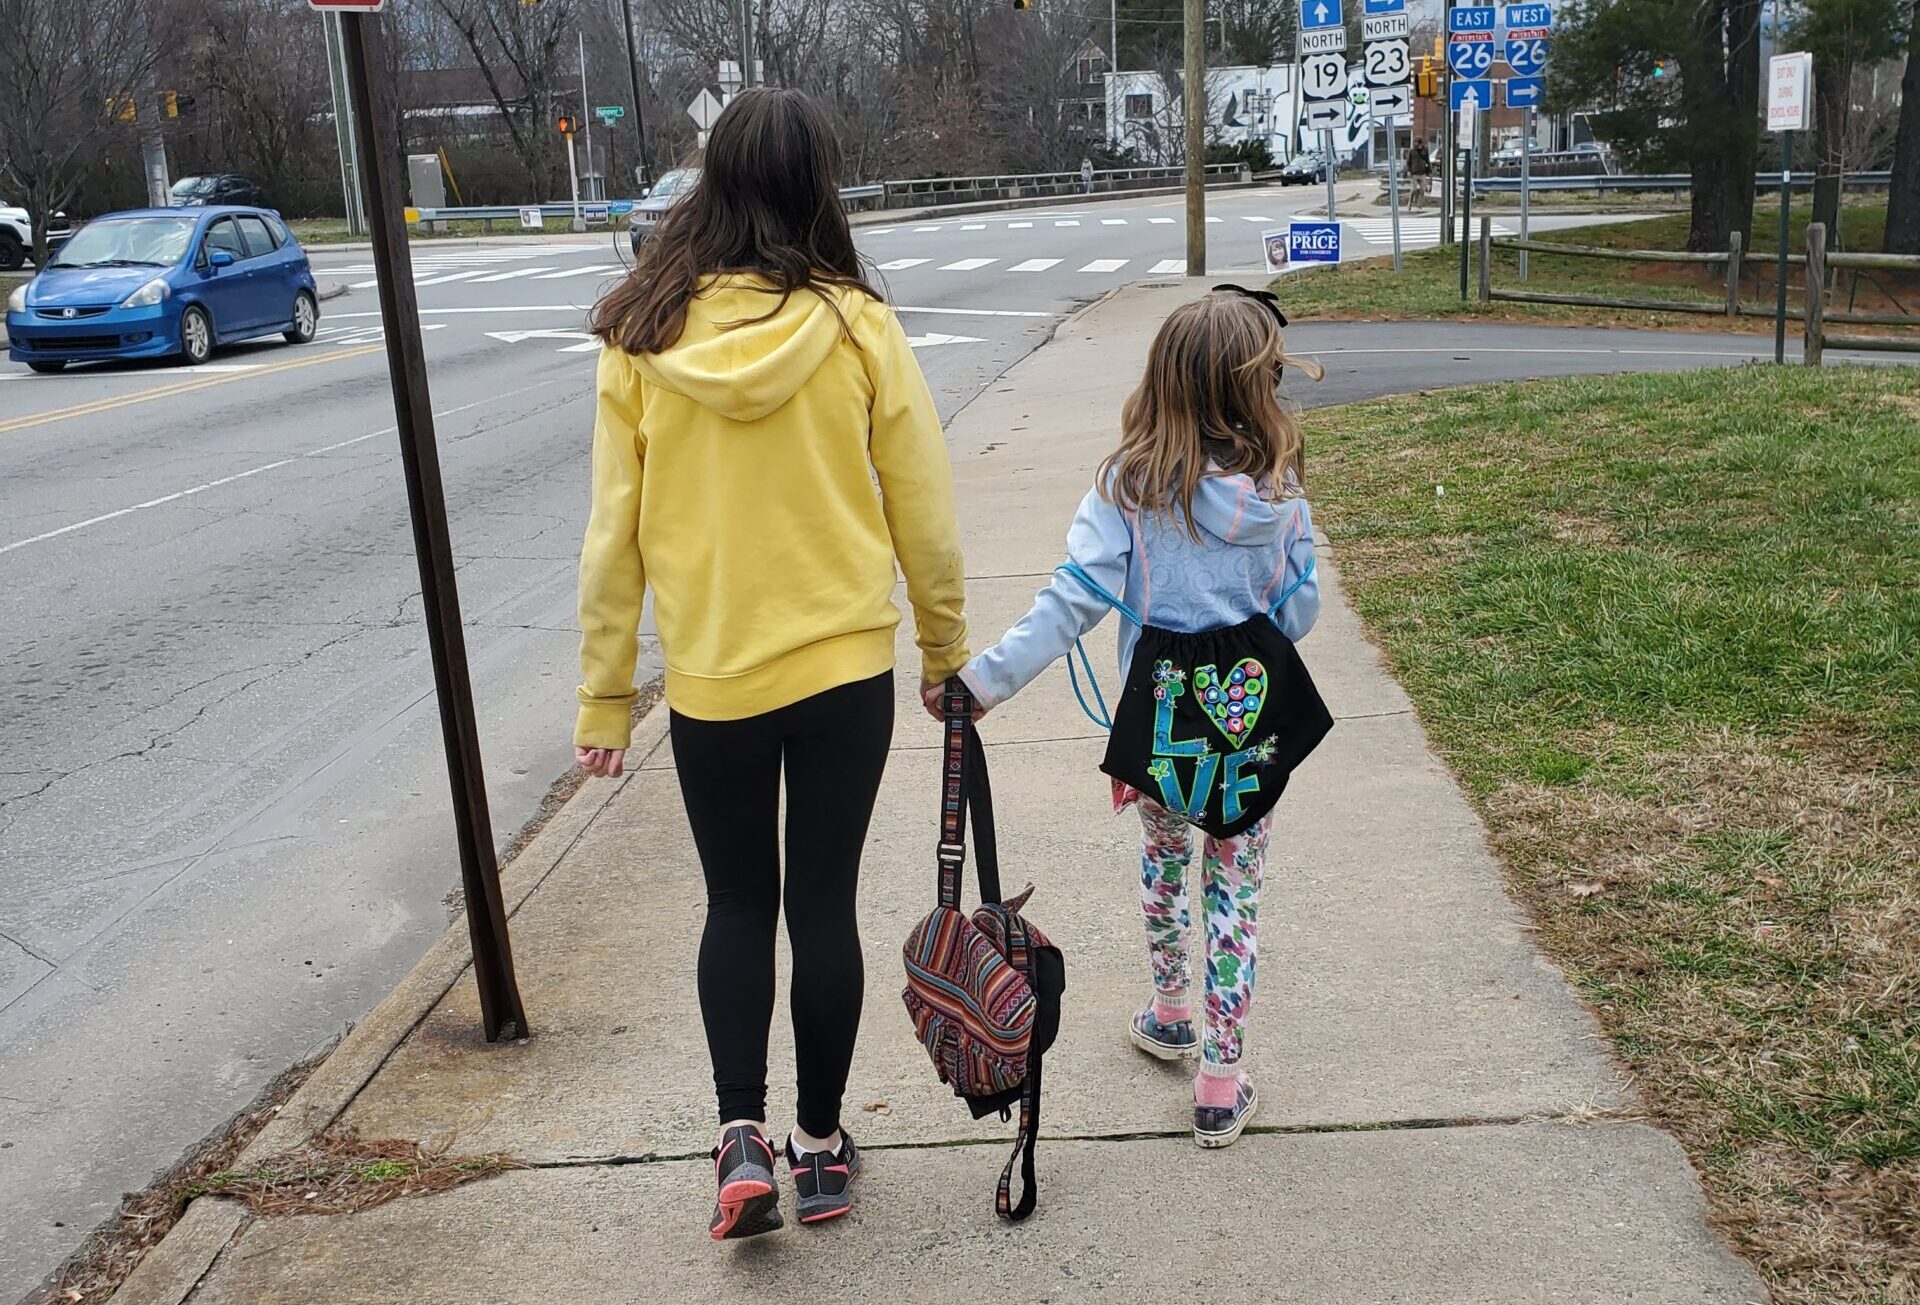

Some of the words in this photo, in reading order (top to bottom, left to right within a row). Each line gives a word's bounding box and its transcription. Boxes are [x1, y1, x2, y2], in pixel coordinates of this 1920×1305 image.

[1456, 12, 1489, 26] EAST
[1511, 8, 1546, 23] WEST
[1365, 18, 1406, 35] NORTH
[1511, 30, 1544, 38] INTERSTATE
[1303, 33, 1343, 48] NORTH
[1455, 43, 1491, 69] 26
[1511, 39, 1546, 66] 26
[1370, 47, 1404, 75] 23
[1314, 62, 1338, 88] 19
[1292, 235, 1338, 249] PRICE
